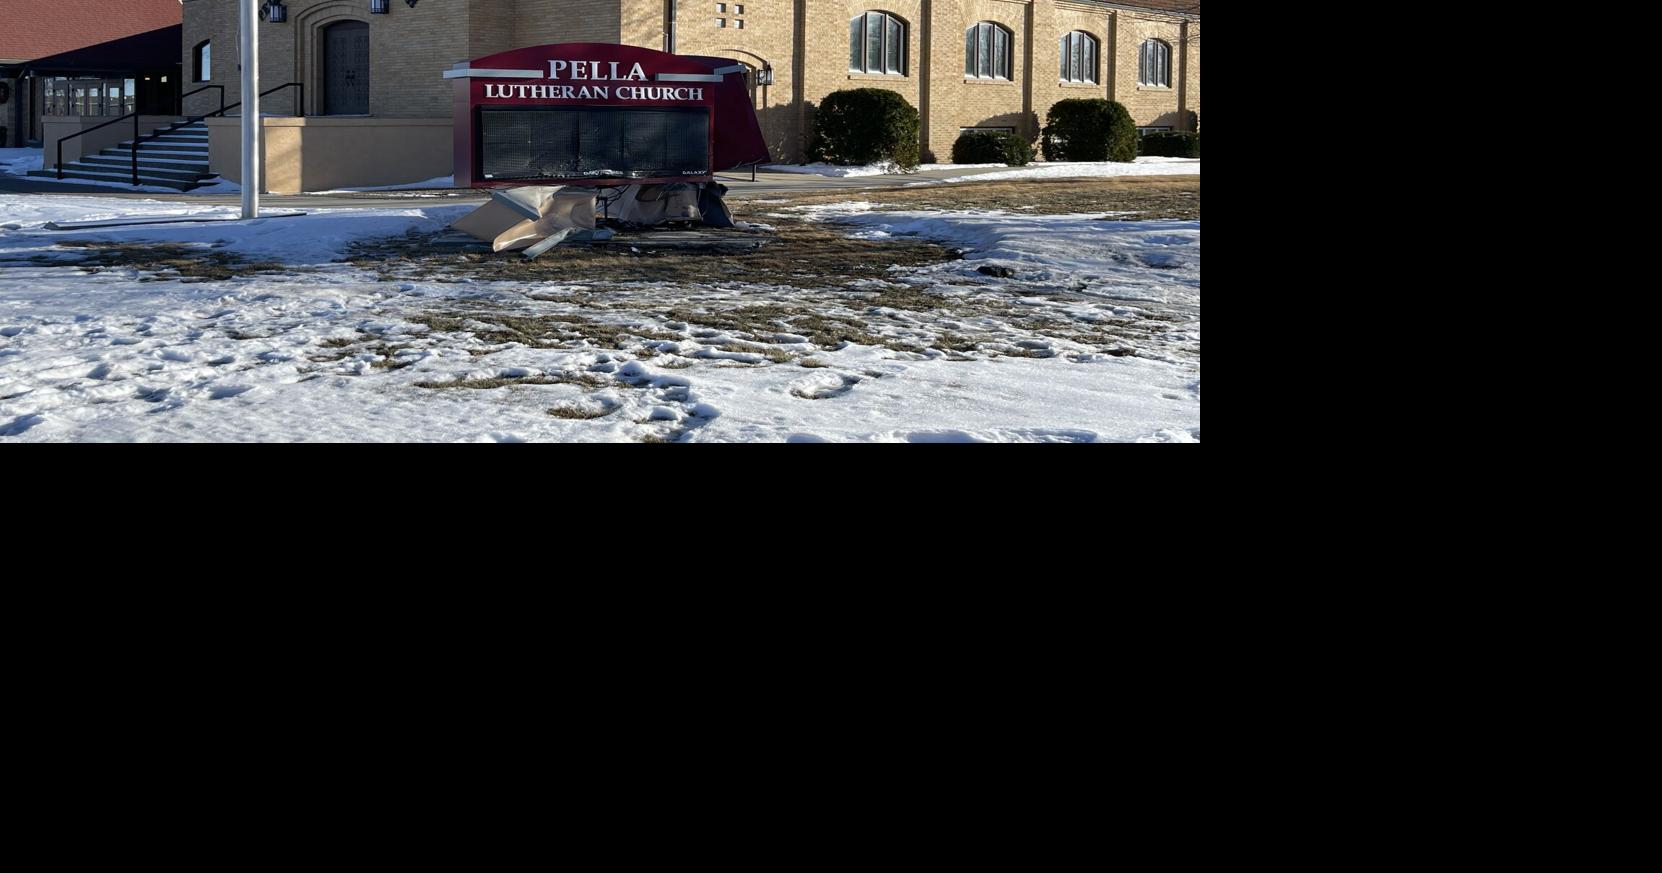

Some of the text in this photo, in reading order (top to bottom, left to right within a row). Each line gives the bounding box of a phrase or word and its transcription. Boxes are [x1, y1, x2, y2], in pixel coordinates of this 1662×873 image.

[547, 60, 648, 80] PELLA
[485, 84, 704, 101] LUTHERAN CHURCH
